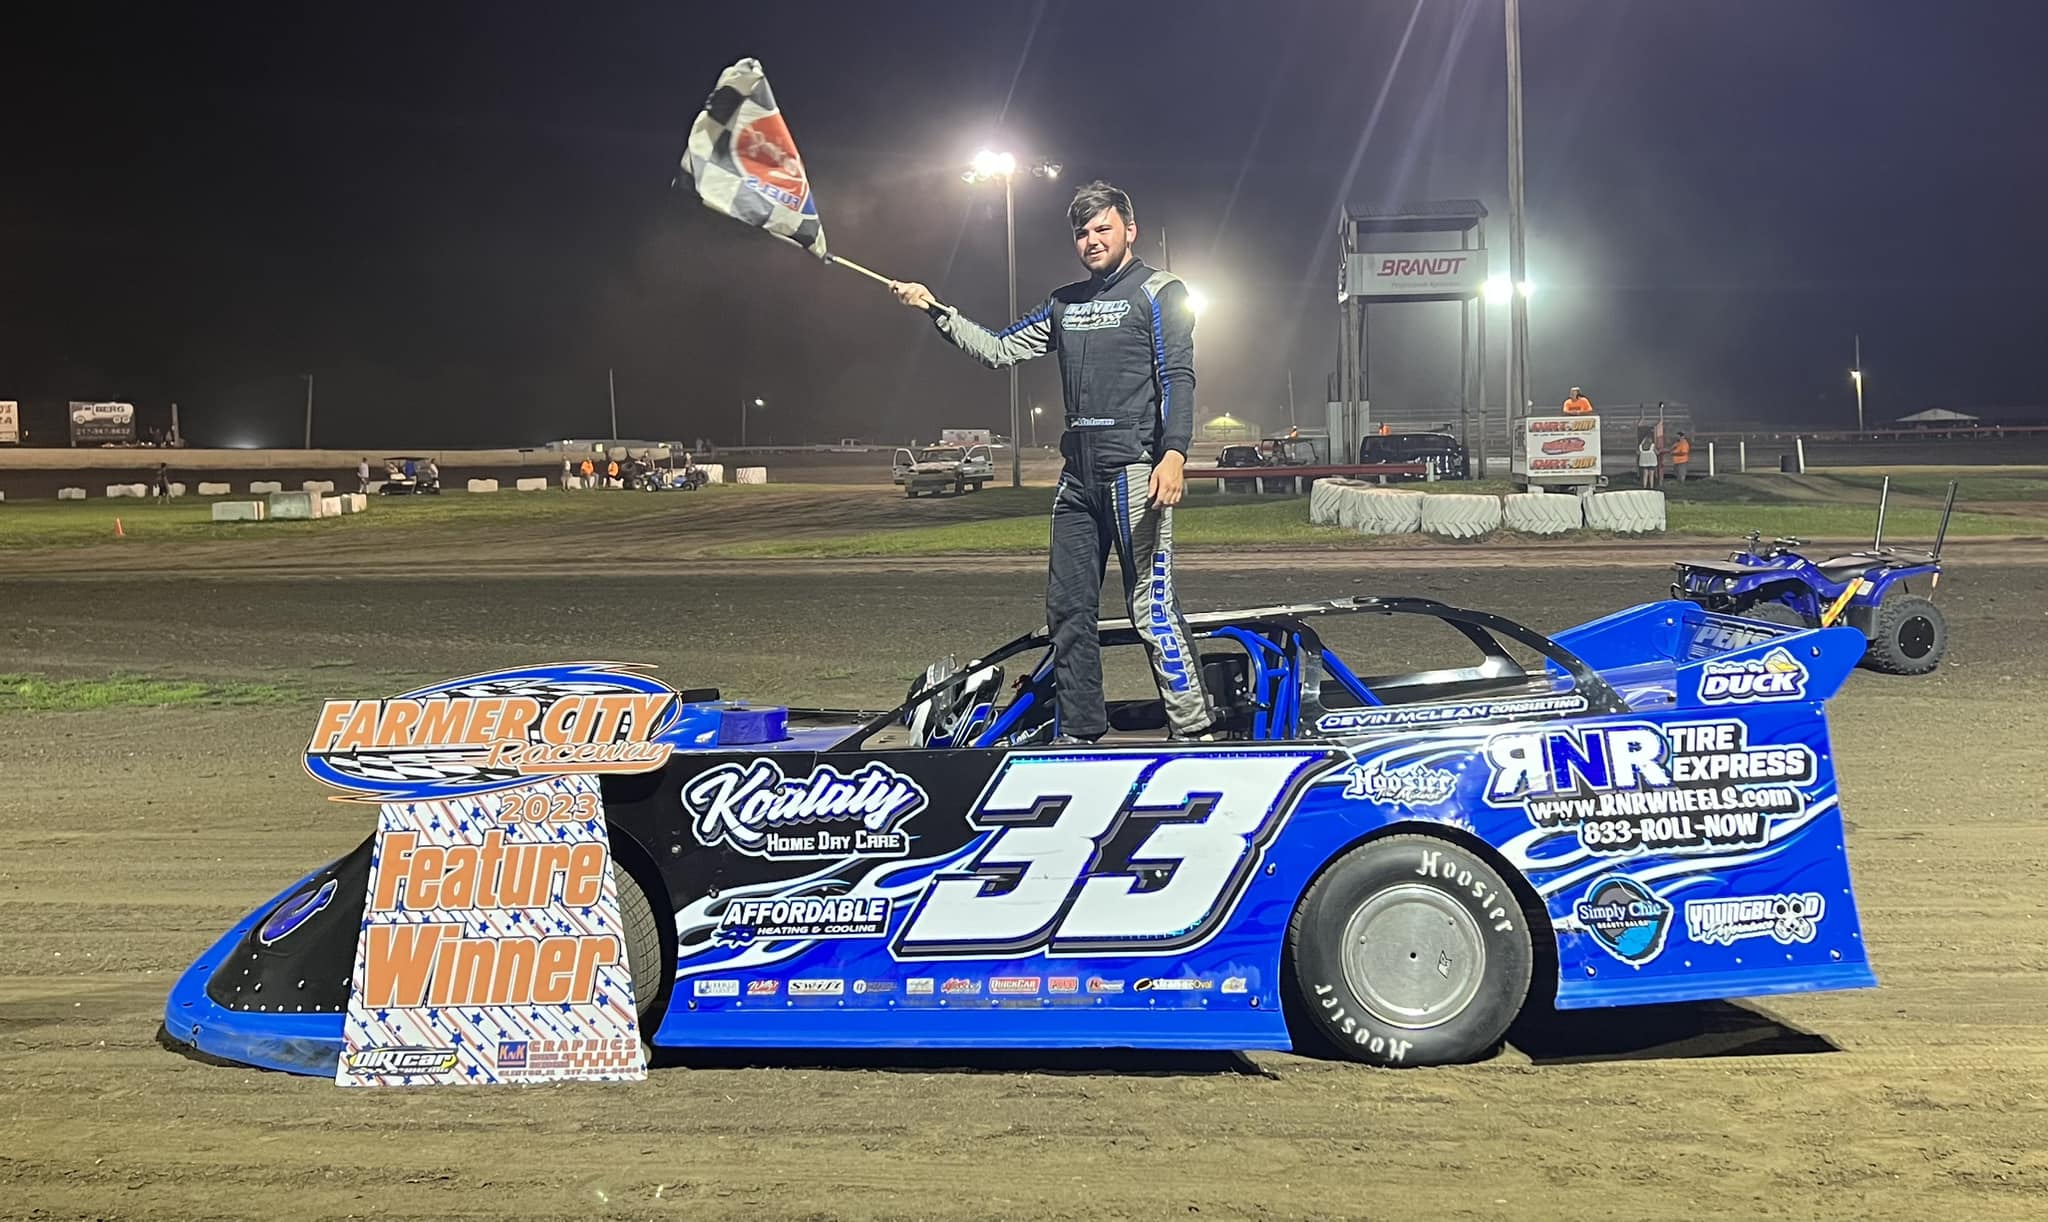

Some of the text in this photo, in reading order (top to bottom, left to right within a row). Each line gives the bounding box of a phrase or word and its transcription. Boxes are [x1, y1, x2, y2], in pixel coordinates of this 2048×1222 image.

[1377, 258, 1467, 276] BRANDT
[1695, 627, 1774, 650] PENS
[1704, 671, 1799, 695] DUCK
[311, 695, 669, 751] FARMER CITY
[1325, 713, 1391, 728] DEVIN
[1489, 699, 1580, 714] CONSULTING
[487, 737, 676, 769] Raceway
[1667, 726, 1735, 754] TIRE
[1346, 765, 1456, 796] Hoosier
[1672, 751, 1805, 782] EXPRESS
[498, 795, 599, 824] 2023
[689, 762, 920, 841] Koalaty
[1584, 813, 1759, 845] 833-ROLL-NOW
[902, 756, 1314, 942] 33
[372, 829, 606, 911] Feature
[1416, 850, 1514, 932] Hoosier
[724, 900, 885, 926] AFFORDABLE
[1580, 901, 1661, 922] Simply Chic
[757, 924, 876, 936] HEATING & COOLING
[363, 922, 620, 1008] Winner
[1314, 983, 1413, 1062] Hoosier
[529, 1039, 637, 1053] GRAPHICS
